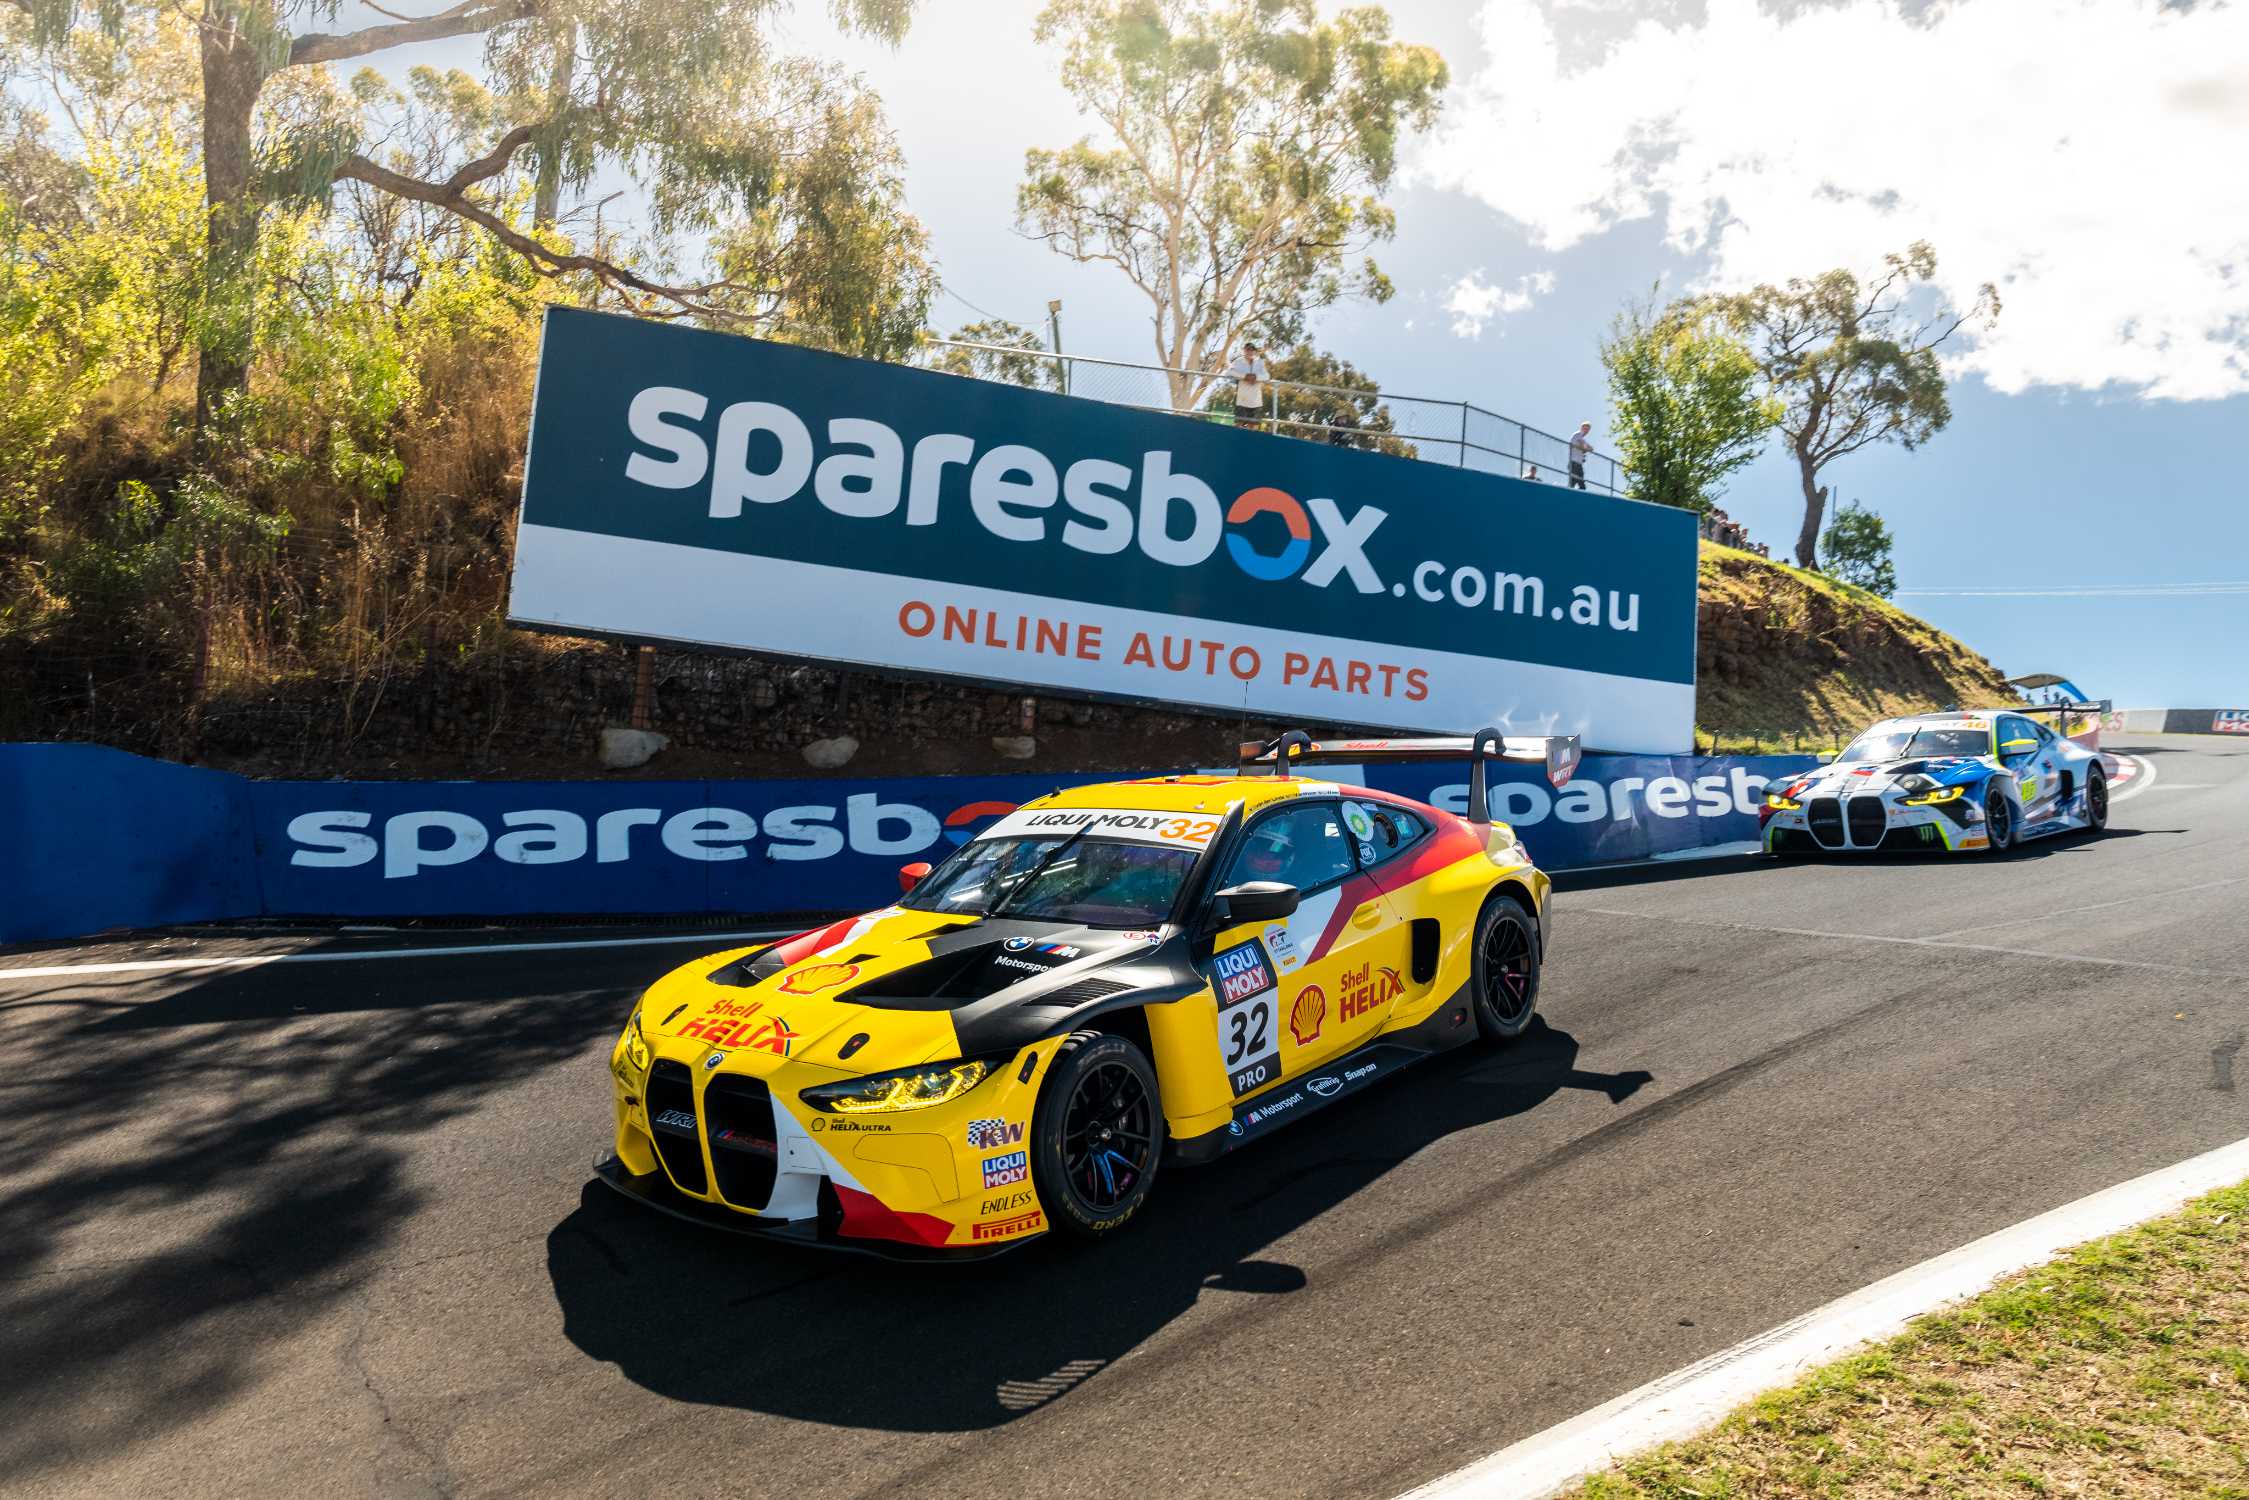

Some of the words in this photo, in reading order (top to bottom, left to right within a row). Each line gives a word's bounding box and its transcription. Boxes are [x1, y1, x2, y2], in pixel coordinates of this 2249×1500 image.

[899, 600, 1102, 661] ONLINE
[1123, 632, 1262, 681] AUTO
[1282, 652, 1430, 702] PARTS
[1026, 814, 1089, 826] LIQUI
[1092, 814, 1168, 829] MOLY
[1159, 818, 1218, 843] 32
[1217, 947, 1258, 978] LIQUI
[1340, 962, 1369, 992] Shell
[1224, 967, 1265, 999] MOLY
[1339, 967, 1406, 1024] HELIX
[705, 999, 763, 1018] Shell
[676, 1016, 800, 1056] HELIX
[1227, 1001, 1269, 1066] 32
[1237, 1065, 1266, 1091] PRO
[1261, 1092, 1304, 1118] Motorsport
[830, 1121, 860, 1131] HELIX
[978, 1120, 1026, 1150] KW
[984, 1152, 1025, 1173] LIQUI
[985, 1167, 1026, 1188] MOLY
[980, 1190, 1032, 1215] ENDLESS
[972, 1210, 1041, 1240] PIRELLI
